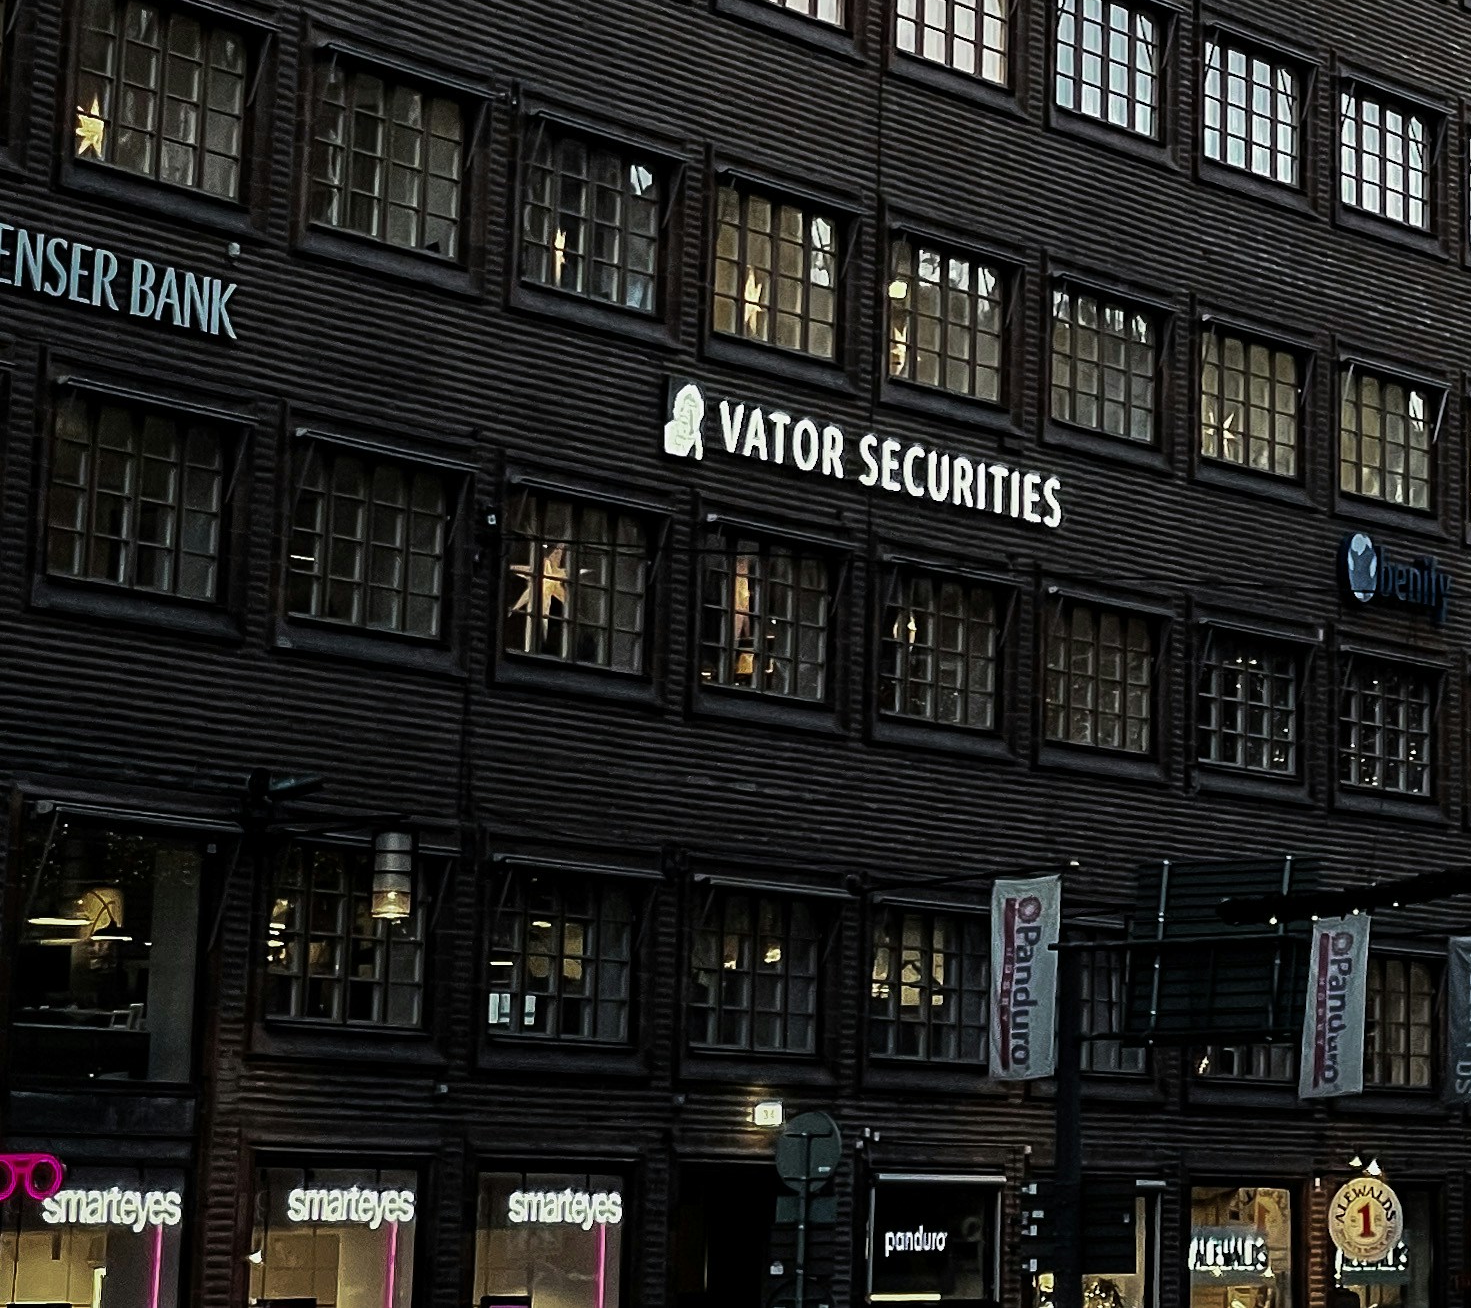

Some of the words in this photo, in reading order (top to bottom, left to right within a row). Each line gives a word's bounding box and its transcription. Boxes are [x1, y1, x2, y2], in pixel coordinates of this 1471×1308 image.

[130, 258, 238, 340] BANK
[718, 399, 846, 480] VATOR
[858, 433, 1063, 529] SECURITIES
[1010, 925, 1042, 1065] Panduro
[41, 1186, 182, 1233] smarteyes
[287, 1186, 415, 1231] smarteyes
[507, 1188, 623, 1231] smarteyes
[1335, 1186, 1396, 1223] ALEWALDS
[1358, 1202, 1375, 1238] 1
[884, 1225, 947, 1258] panduro
